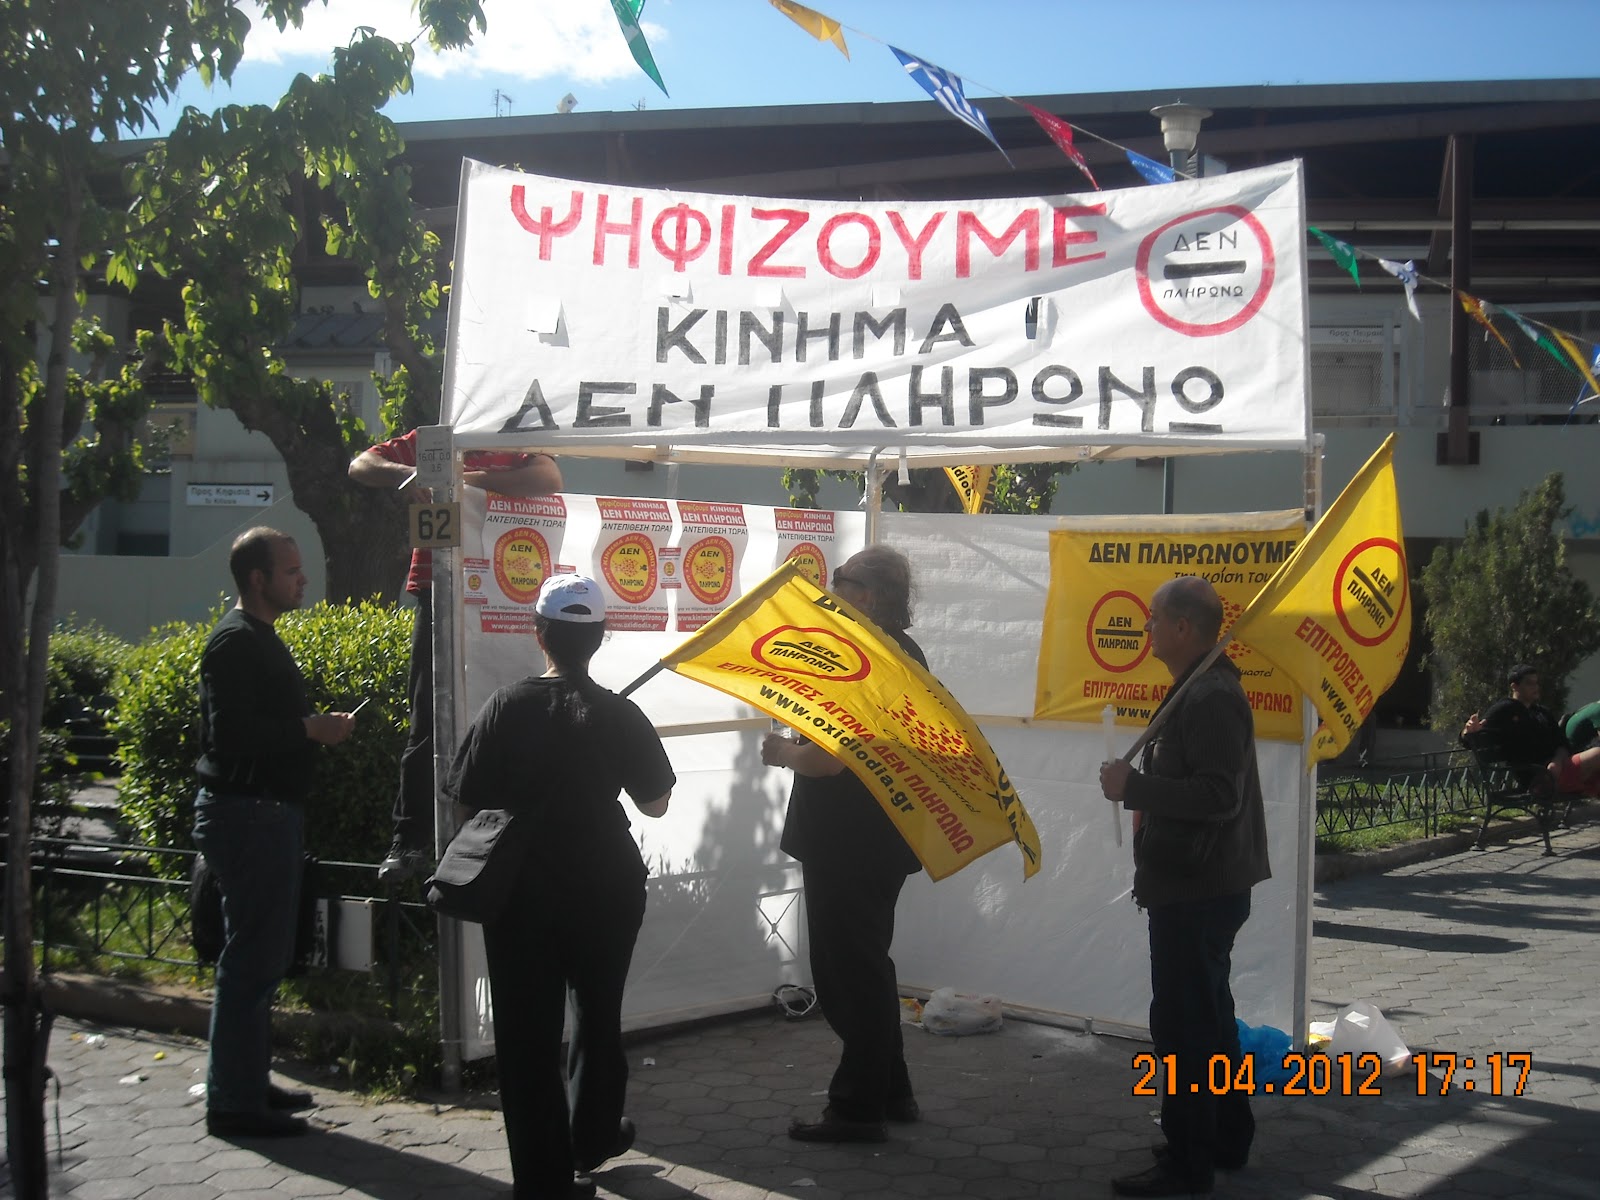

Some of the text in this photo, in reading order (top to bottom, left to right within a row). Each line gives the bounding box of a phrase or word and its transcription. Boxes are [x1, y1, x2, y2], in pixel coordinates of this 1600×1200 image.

[511, 184, 1107, 279] ΨΗΦΙΖΟΥΜΕ
[1173, 230, 1238, 252] ΔΕΝ
[1163, 285, 1244, 300] ΠΛΗΡΩΝΩ
[656, 303, 976, 366] ΚΙΝΗΜΑ
[497, 364, 1225, 434] ΔΕΝ ΠΛΗΡΩΝΩ
[489, 500, 565, 516] ΔΕΝ ΠΛΗΡΩΝΩ
[631, 502, 666, 510] ΚΙΝΗΜΑ
[709, 505, 741, 513] ΚΙΝΗΜΑ
[486, 515, 540, 526] ΑΝΤΕΠΙΘΕΣΗ
[602, 509, 671, 520] ΔΕΝ ΠΛΗΡΩΝΩ
[682, 512, 745, 524] ΔΕΝ ΠΛΗΡΩΝΩ
[803, 513, 832, 521] ΚΙΝΗΜΑ
[418, 509, 450, 540] 62
[602, 523, 650, 532] ΑΝΤΕΠΙΘΕΣΗ
[683, 525, 727, 535] ΑΝΤΕΠΙΘΕΣΗ
[777, 520, 833, 532] ΔΕΝ ΠΛΗΡΩΝΩ
[510, 544, 532, 552] ΔΕΝ
[619, 547, 641, 555] ΔΕΝ
[1088, 542, 1131, 564] ΔΕΝ
[1370, 567, 1395, 598] ΔΕΝ
[1346, 579, 1388, 629] ΠΛΗΡΩΝΩ
[1107, 616, 1132, 628] ΔΕΝ
[798, 640, 842, 659] ΔΕΝ
[1097, 637, 1139, 650] ΠΛΗΡΩΝΩ
[768, 647, 836, 673] ΠΛΗΡΩΝΩ
[1294, 616, 1364, 695] ΕΠΙΤΡΟΠΕΣ
[1083, 679, 1148, 701] ΕΠΙΤΡΟΠΕΣ
[1247, 691, 1293, 714] ΗΡΩΝΩ
[759, 683, 916, 815] www.oxidiodia.gr
[717, 661, 975, 855] ΕΠΙΤΡΟΠΕΣ ΑΓΩΝΑ ΔΕΝ ΠΛΗΡΩΝΩ
